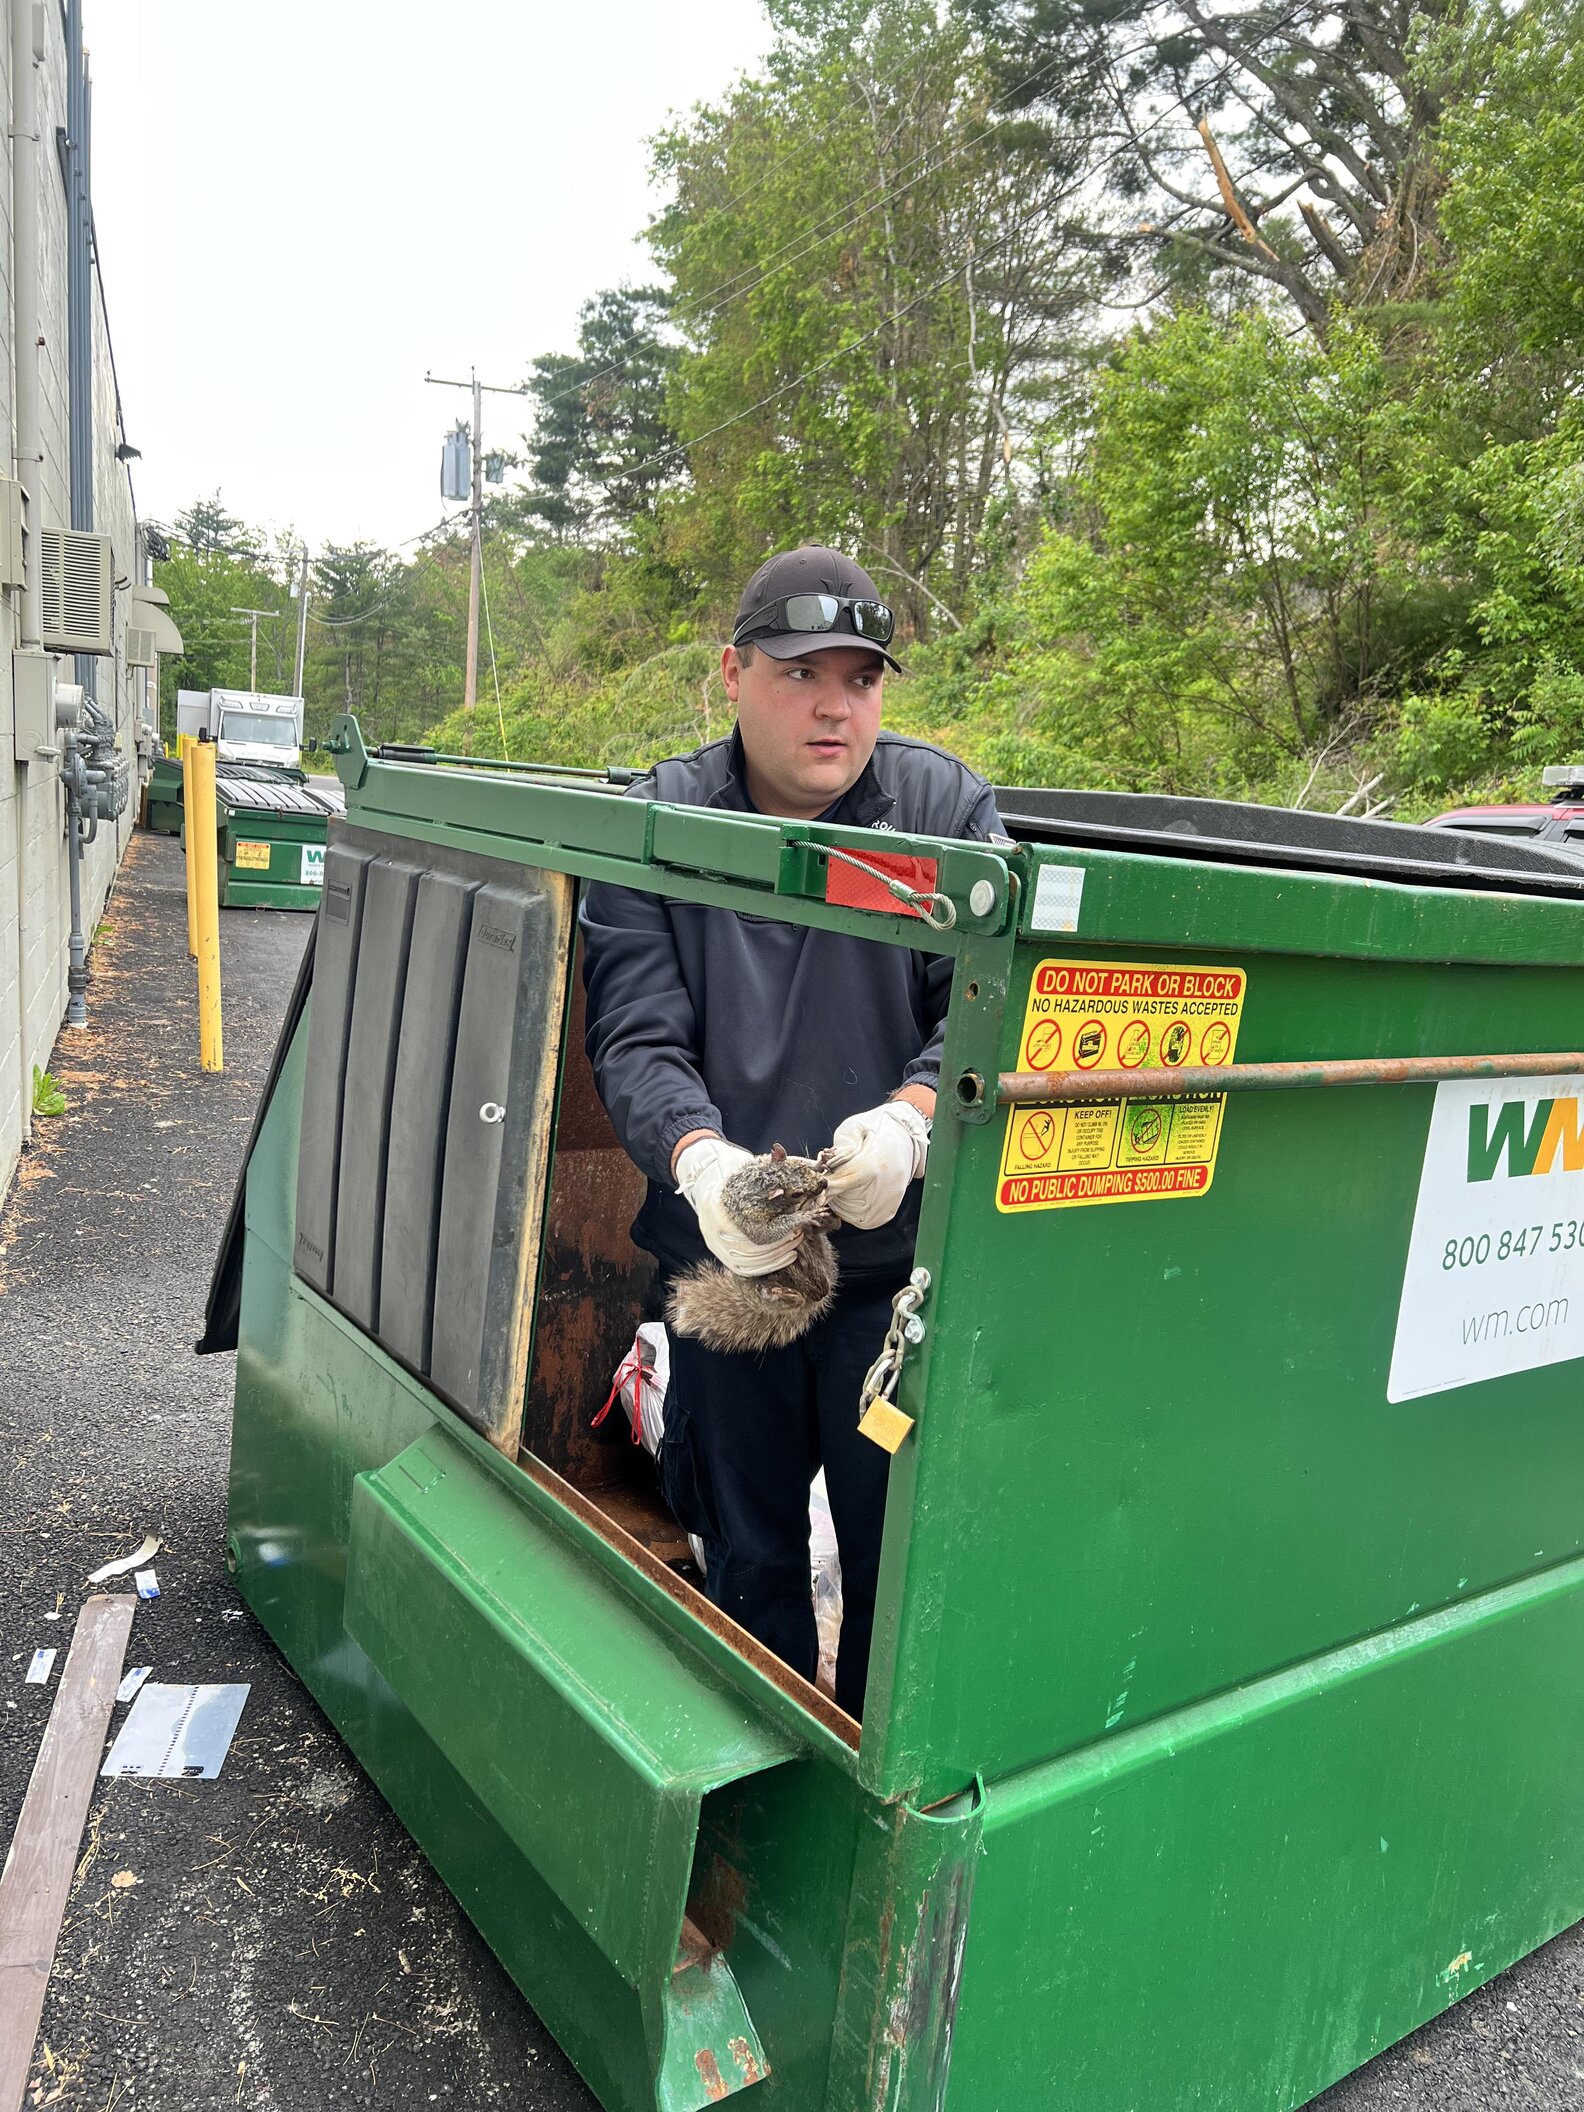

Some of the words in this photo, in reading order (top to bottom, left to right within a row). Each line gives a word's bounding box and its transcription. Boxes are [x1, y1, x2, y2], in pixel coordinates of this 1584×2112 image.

[1043, 970, 1069, 992] DO
[1073, 972, 1108, 993] NOT
[1111, 974, 1154, 995] PARK
[1157, 975, 1181, 996] OR
[1183, 976, 1236, 997] BLOCK
[1032, 998, 1051, 1012] NO
[1053, 999, 1128, 1014] HAZARDOUS
[1132, 1000, 1178, 1015] WASTES
[1180, 1002, 1238, 1016] ACCEPTED
[1074, 1110, 1094, 1119] KEEP
[1095, 1110, 1112, 1119] OFF!
[1009, 1181, 1029, 1202] NO
[1031, 1177, 1076, 1200] PUBLIC
[1078, 1173, 1132, 1196] DUMPING
[1134, 1171, 1174, 1192] $500.00
[1175, 1169, 1202, 1189] FINE
[1442, 1233, 1490, 1270] 800
[1497, 1225, 1544, 1261] 847
[1462, 1298, 1569, 1345] wm.com
